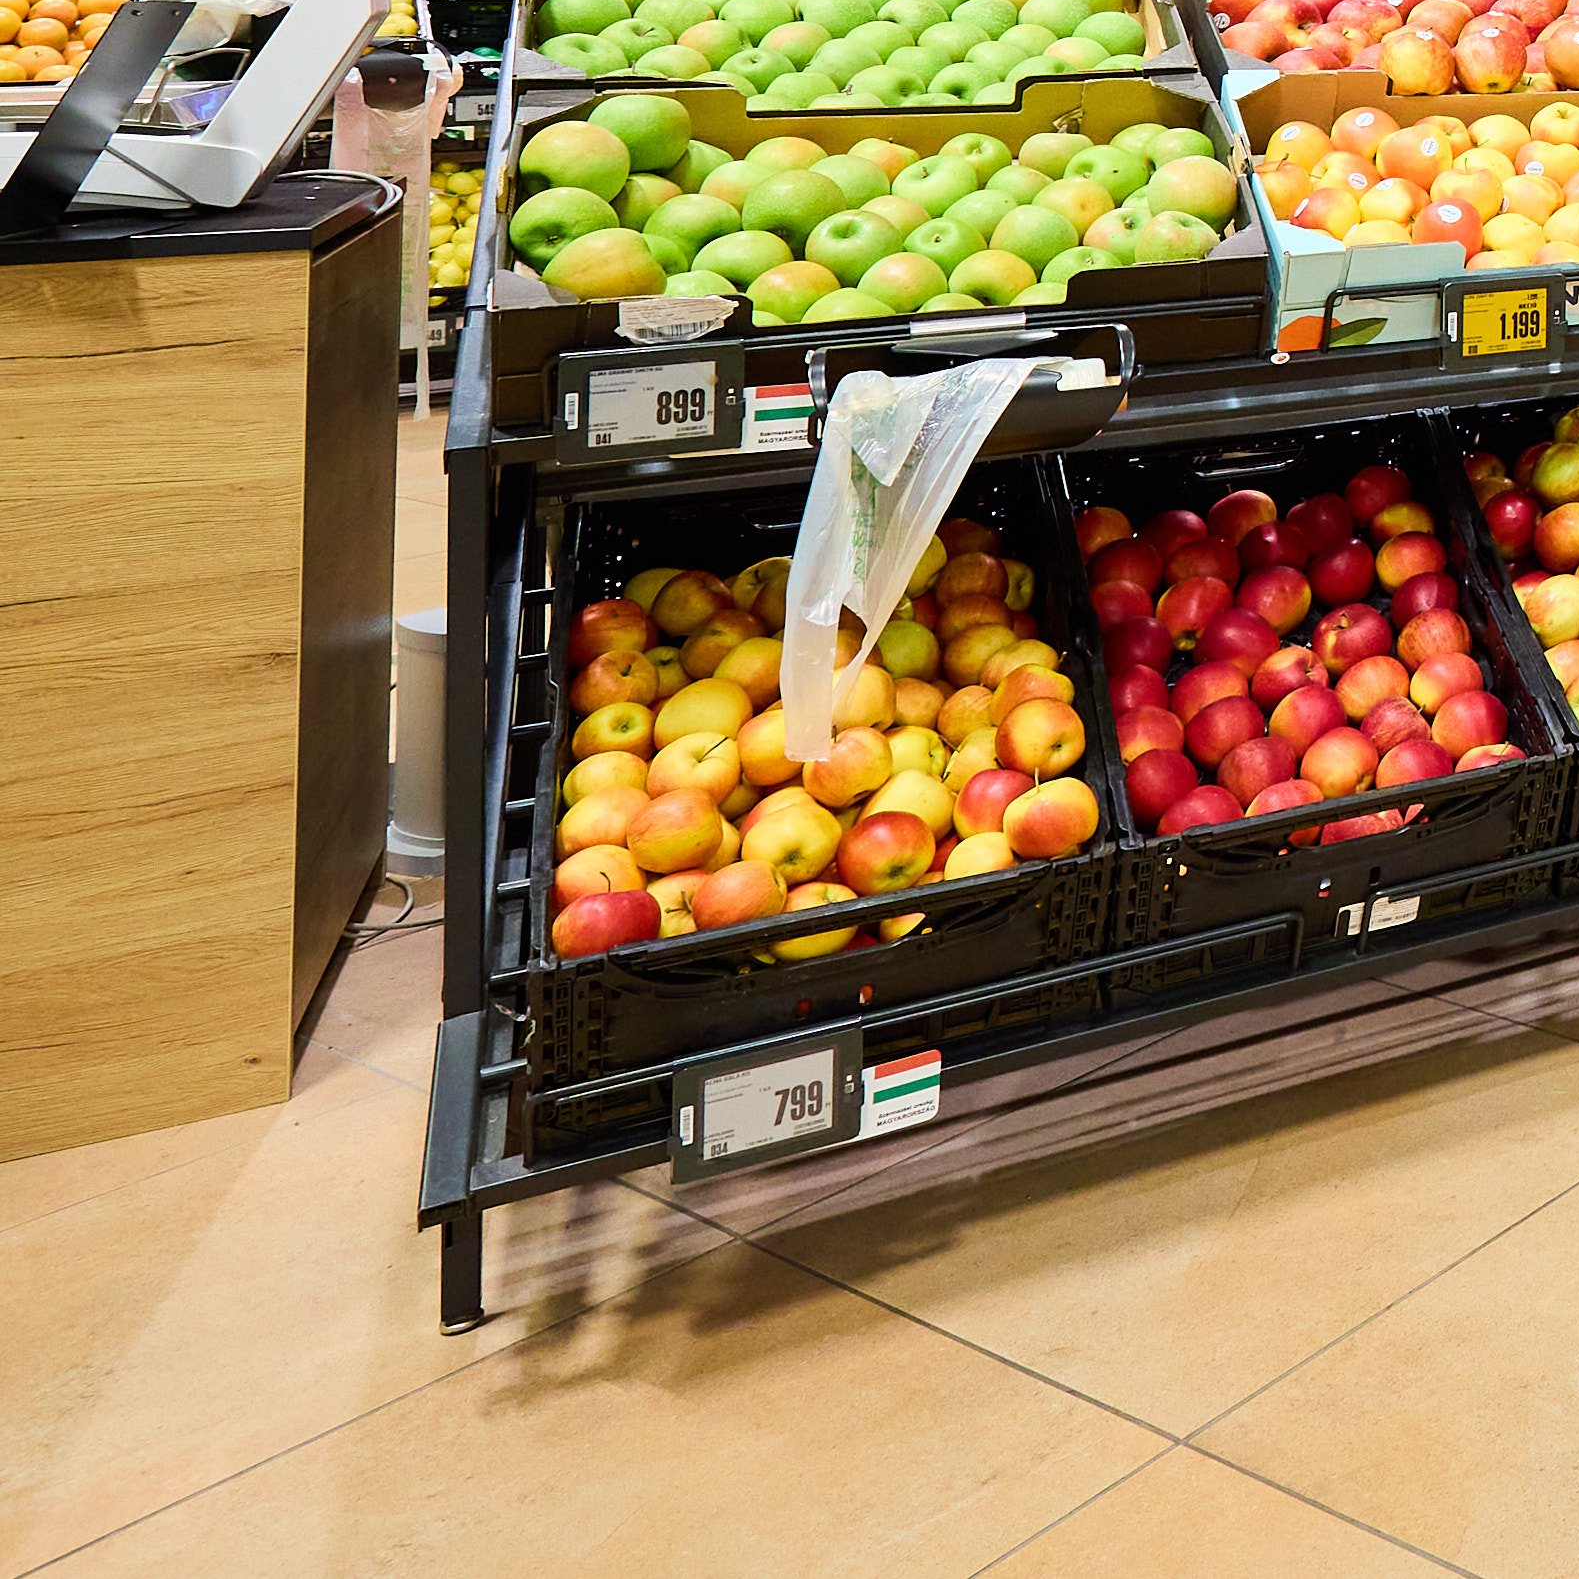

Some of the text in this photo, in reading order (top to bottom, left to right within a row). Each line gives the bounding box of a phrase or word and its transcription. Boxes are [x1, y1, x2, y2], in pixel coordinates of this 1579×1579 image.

[1500, 309, 1540, 341] 1.199
[656, 388, 705, 425] 899
[595, 432, 612, 445] 041
[773, 1080, 823, 1127] 799
[876, 1105, 936, 1127] MAGYARORSZÁG
[710, 1141, 728, 1157] 034
